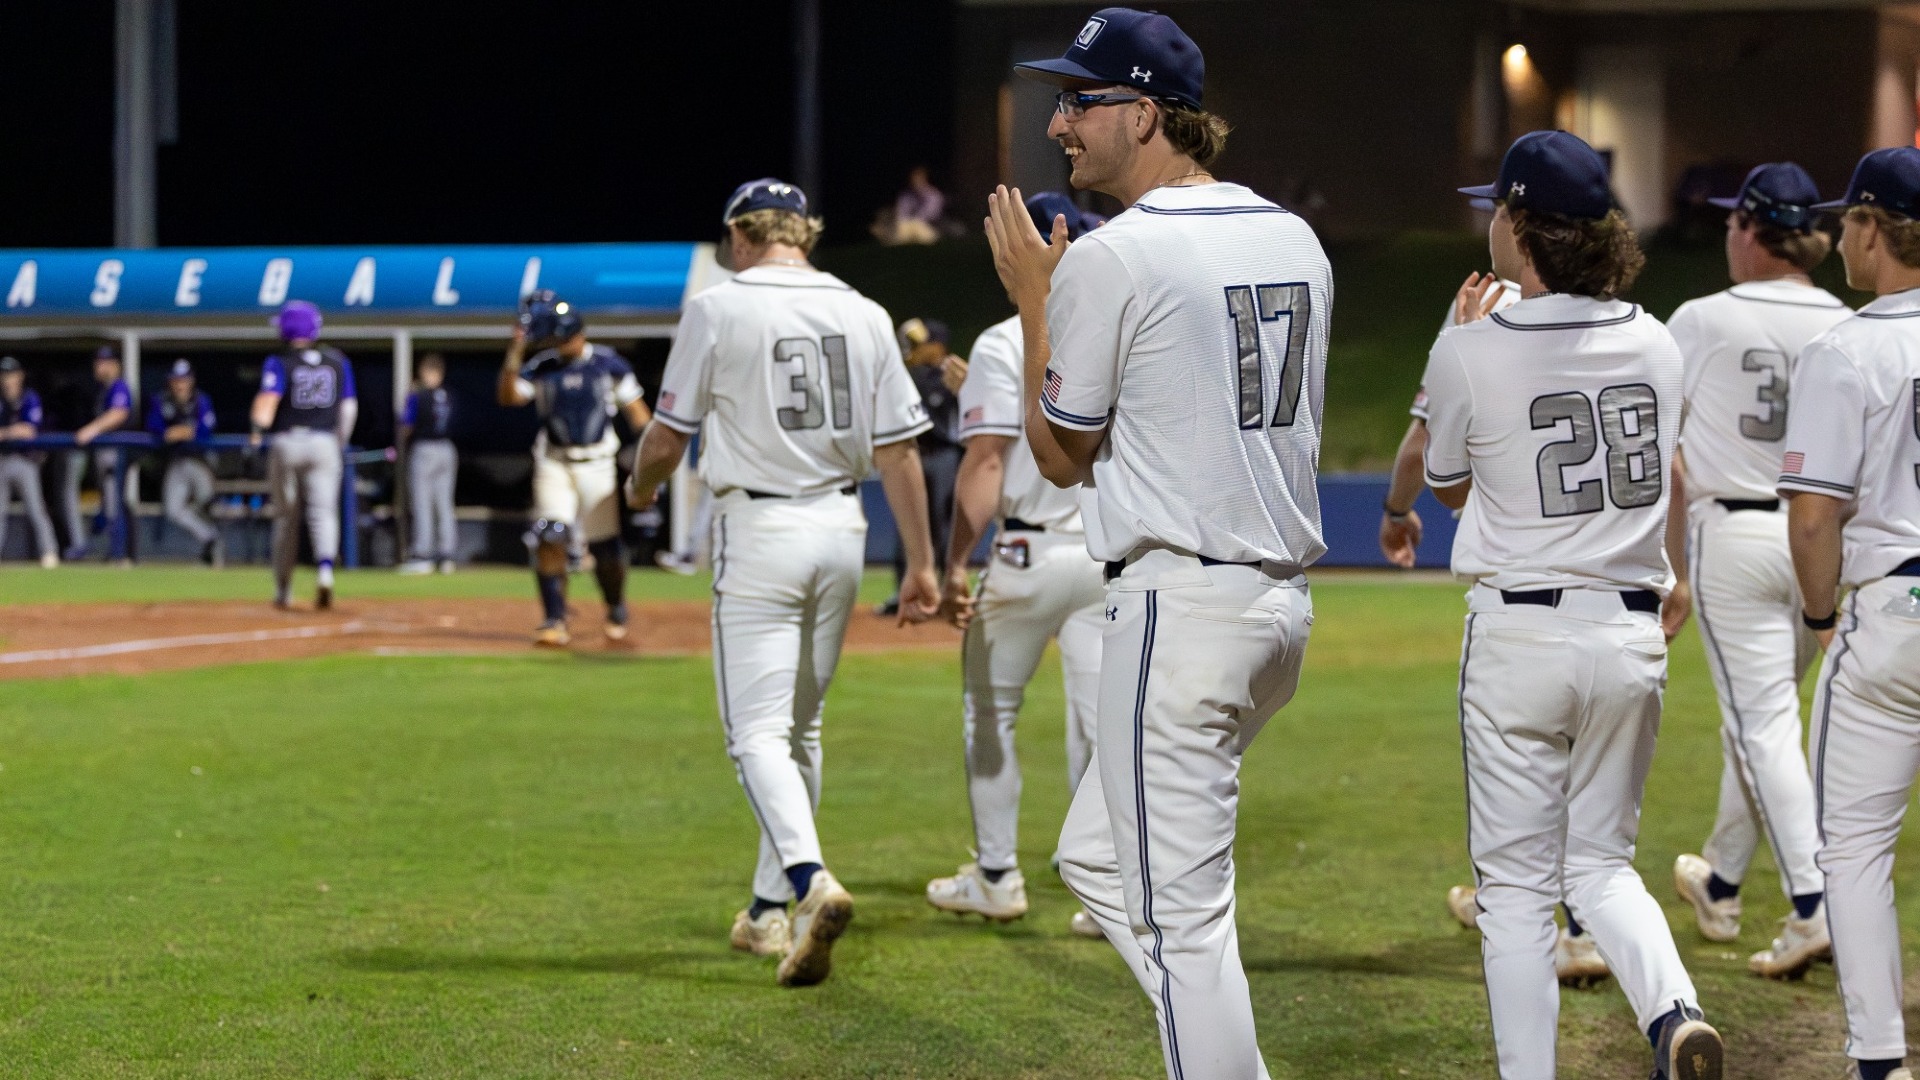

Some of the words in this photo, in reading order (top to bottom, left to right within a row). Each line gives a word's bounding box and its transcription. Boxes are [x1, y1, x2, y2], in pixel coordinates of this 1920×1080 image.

[772, 335, 852, 431] 31
[1224, 282, 1311, 430] 17
[1738, 348, 1798, 443] 3
[1529, 383, 1663, 518] 28
